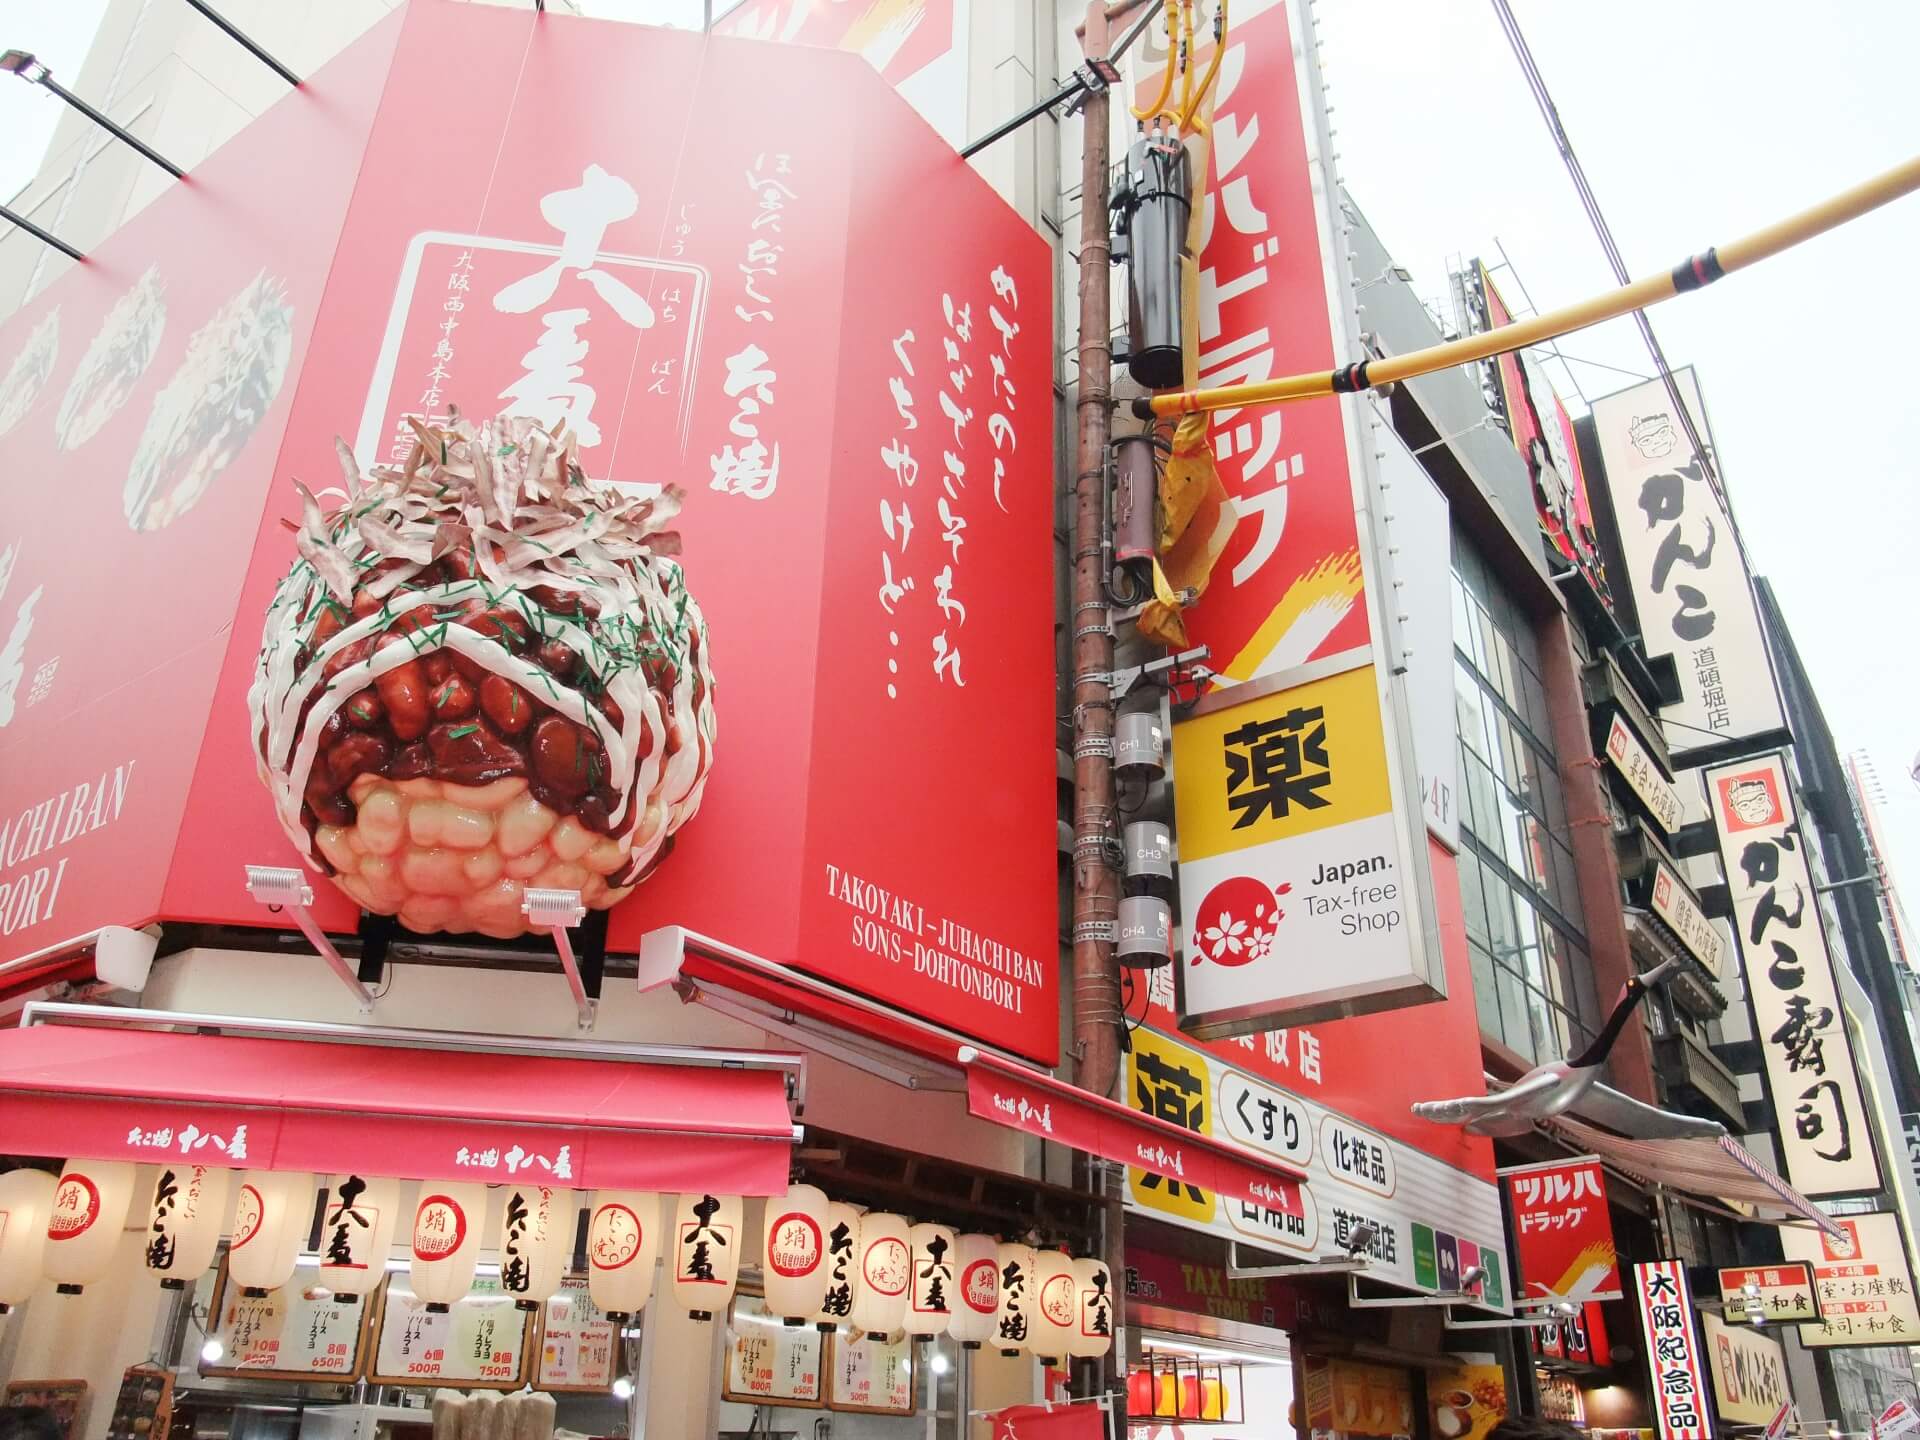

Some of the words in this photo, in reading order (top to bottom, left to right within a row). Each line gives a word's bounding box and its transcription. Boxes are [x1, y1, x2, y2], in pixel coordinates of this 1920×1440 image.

[1637, 444, 1716, 642] がんこ
[1692, 646, 1731, 731] 道頓堀店
[1119, 740, 1140, 751] CH1
[1223, 705, 1332, 831] 薬
[1136, 849, 1162, 859] CH3
[1311, 854, 1393, 889] Japan.
[1303, 880, 1398, 917] Tax-free
[1122, 926, 1146, 938] CH4
[1341, 910, 1401, 937] Shop
[1236, 1088, 1299, 1150] くすり
[1333, 1128, 1387, 1186] 化粧品
[1514, 1169, 1602, 1207] ツルハ
[1519, 1207, 1588, 1234] ドラッグ
[784, 1226, 807, 1251] 蛸
[1181, 1263, 1223, 1299] TAX
[311, 1356, 344, 1368] 650円
[424, 1349, 444, 1361] 6個
[492, 1352, 513, 1364] 8個
[1647, 1272, 1698, 1430] 大阪紀念品
[408, 1363, 441, 1374] 500円
[479, 1366, 511, 1377] 750円
